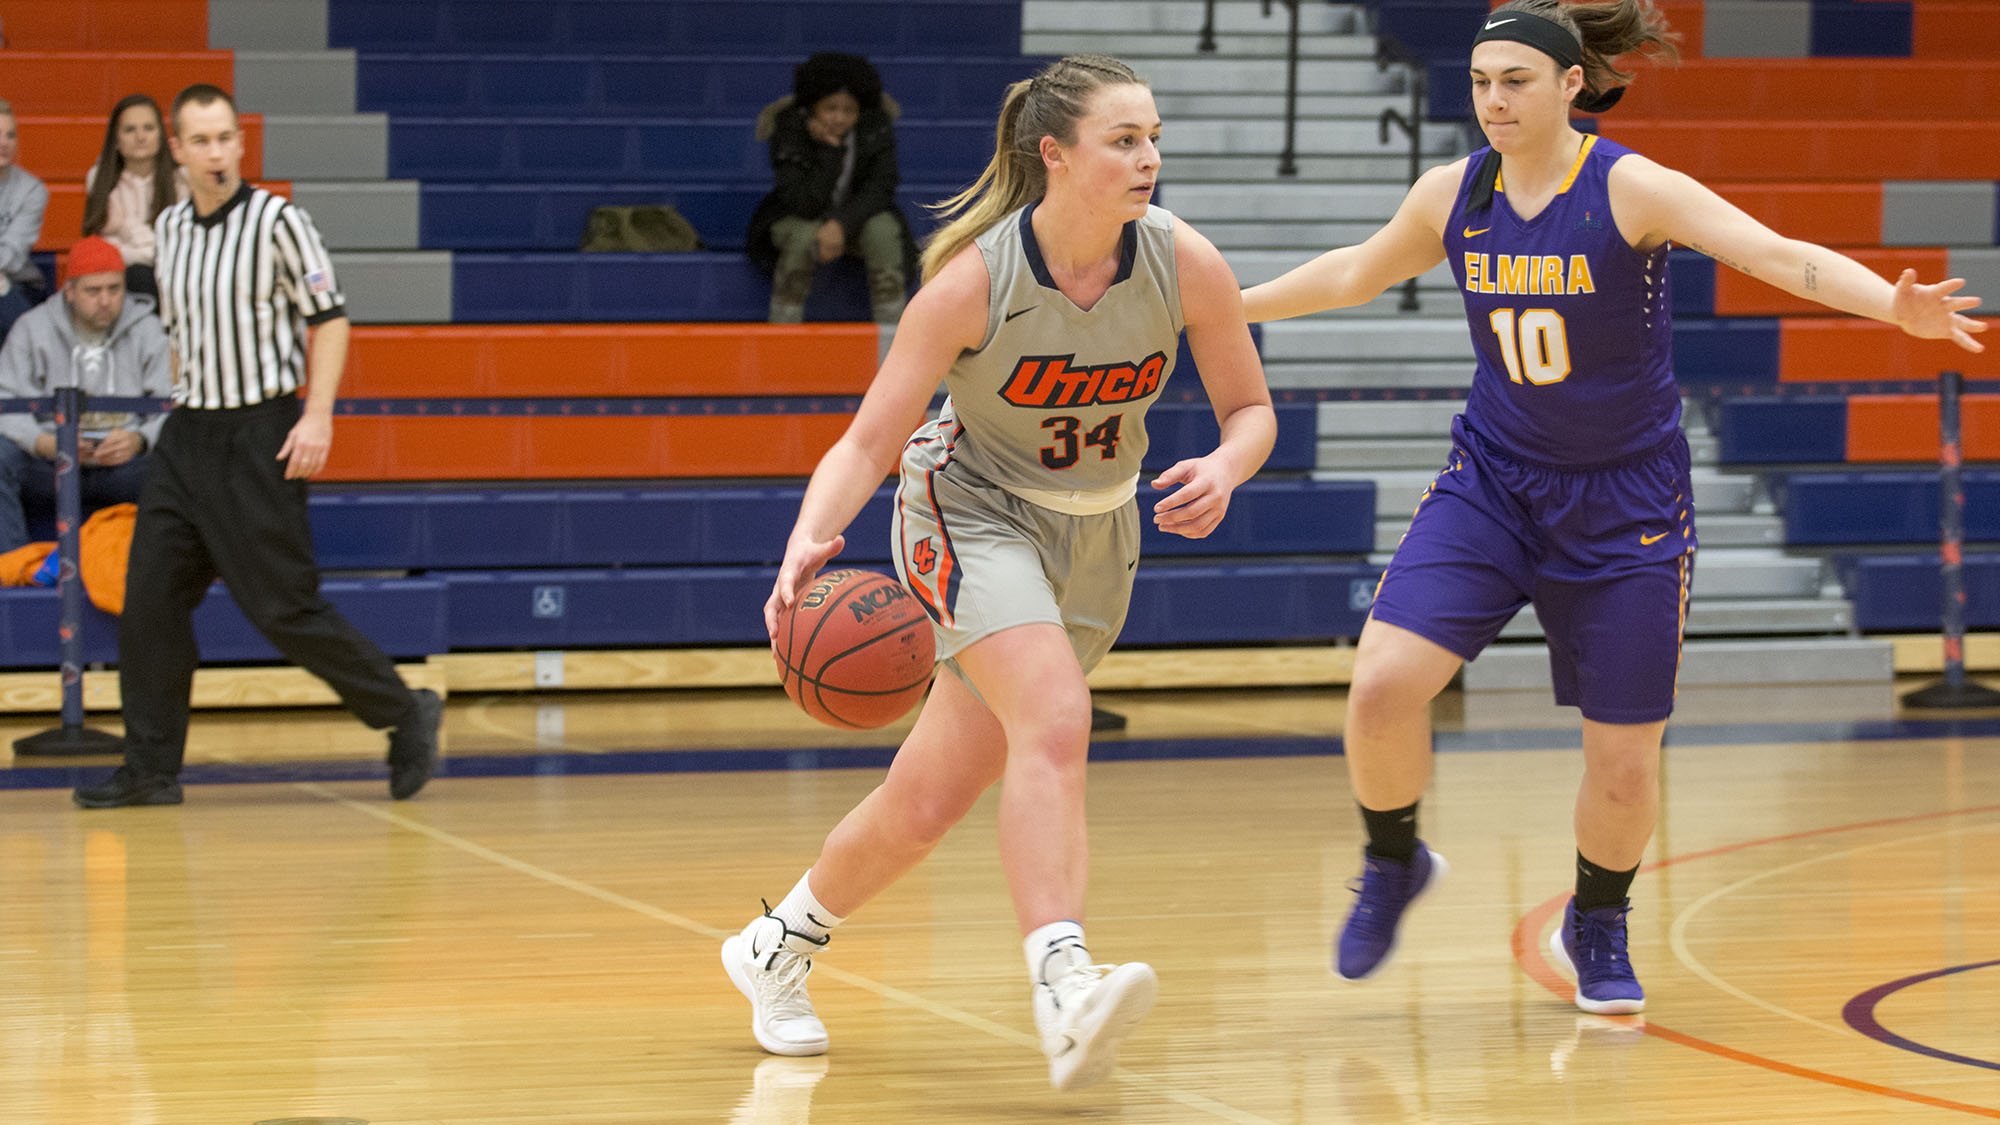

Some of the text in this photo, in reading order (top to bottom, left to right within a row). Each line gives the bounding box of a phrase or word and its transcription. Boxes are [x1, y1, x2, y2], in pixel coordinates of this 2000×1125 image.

[1464, 251, 1596, 295] ELMIRA
[1489, 308, 1571, 386] 10
[997, 350, 1168, 409] UTICA
[1039, 412, 1124, 471] 34
[913, 536, 937, 576] UC
[848, 583, 912, 623] NCAA
